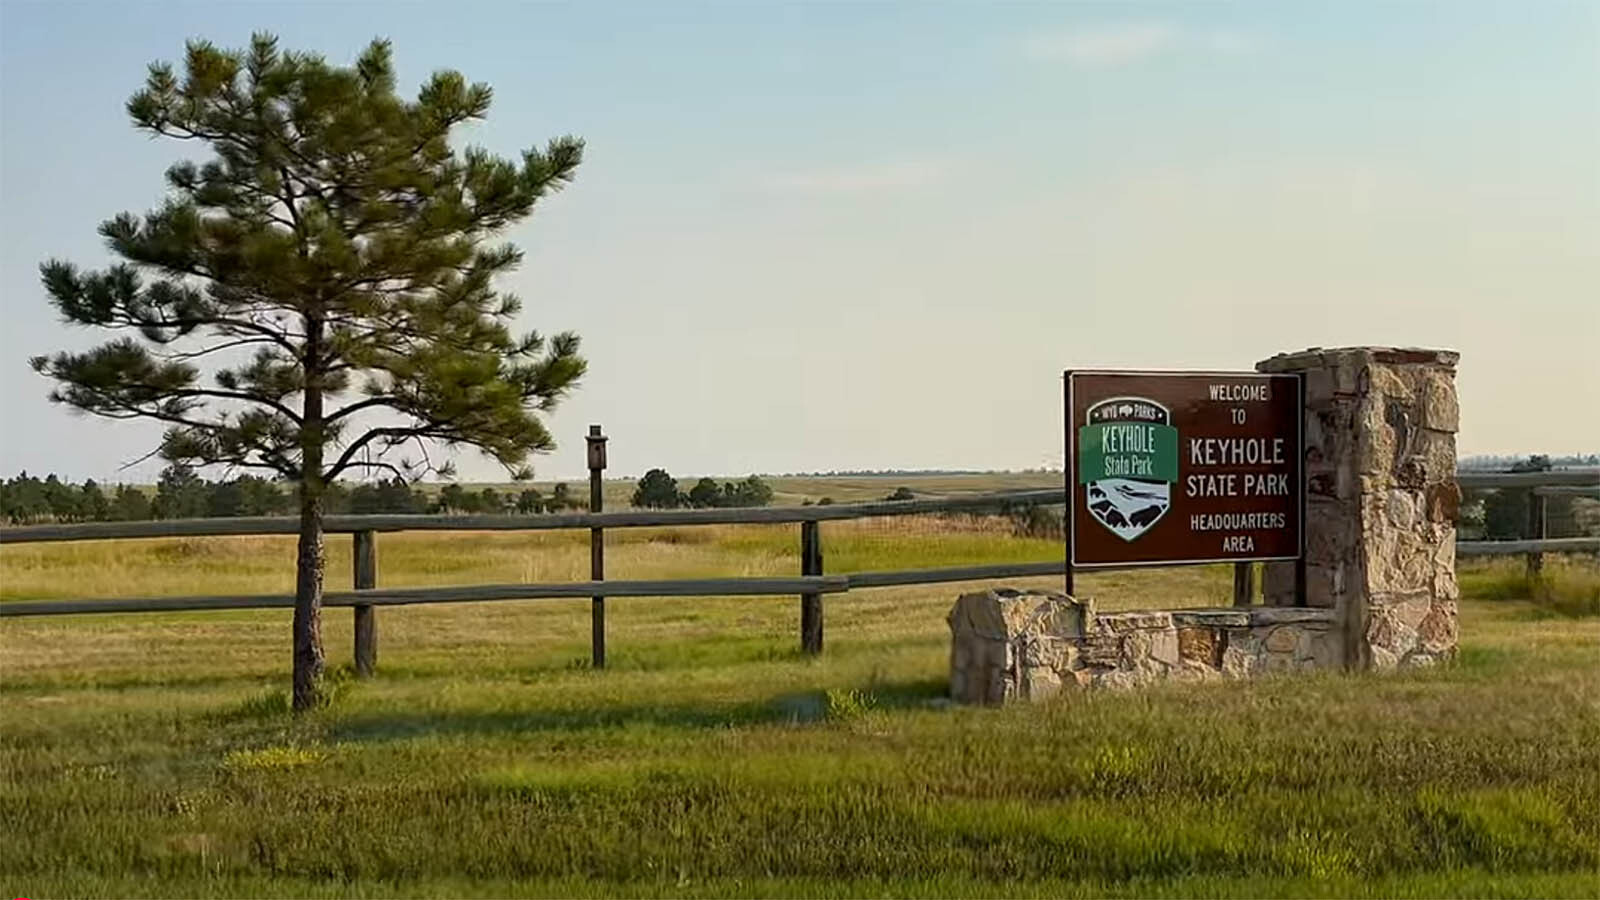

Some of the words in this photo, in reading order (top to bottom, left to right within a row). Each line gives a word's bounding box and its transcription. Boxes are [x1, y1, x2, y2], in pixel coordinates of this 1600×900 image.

[1209, 384, 1267, 401] WELCOME
[1134, 404, 1156, 419] PARKS
[1231, 408, 1246, 424] TO
[1102, 426, 1155, 453] KEYHOLE
[1191, 438, 1285, 465] KEYHOLE
[1105, 456, 1129, 476] State
[1131, 455, 1153, 475] Park
[1186, 474, 1237, 497] STATE
[1244, 473, 1289, 496] PARK
[1190, 513, 1286, 531] HEADQUARTERS
[1222, 536, 1254, 552] AREA
